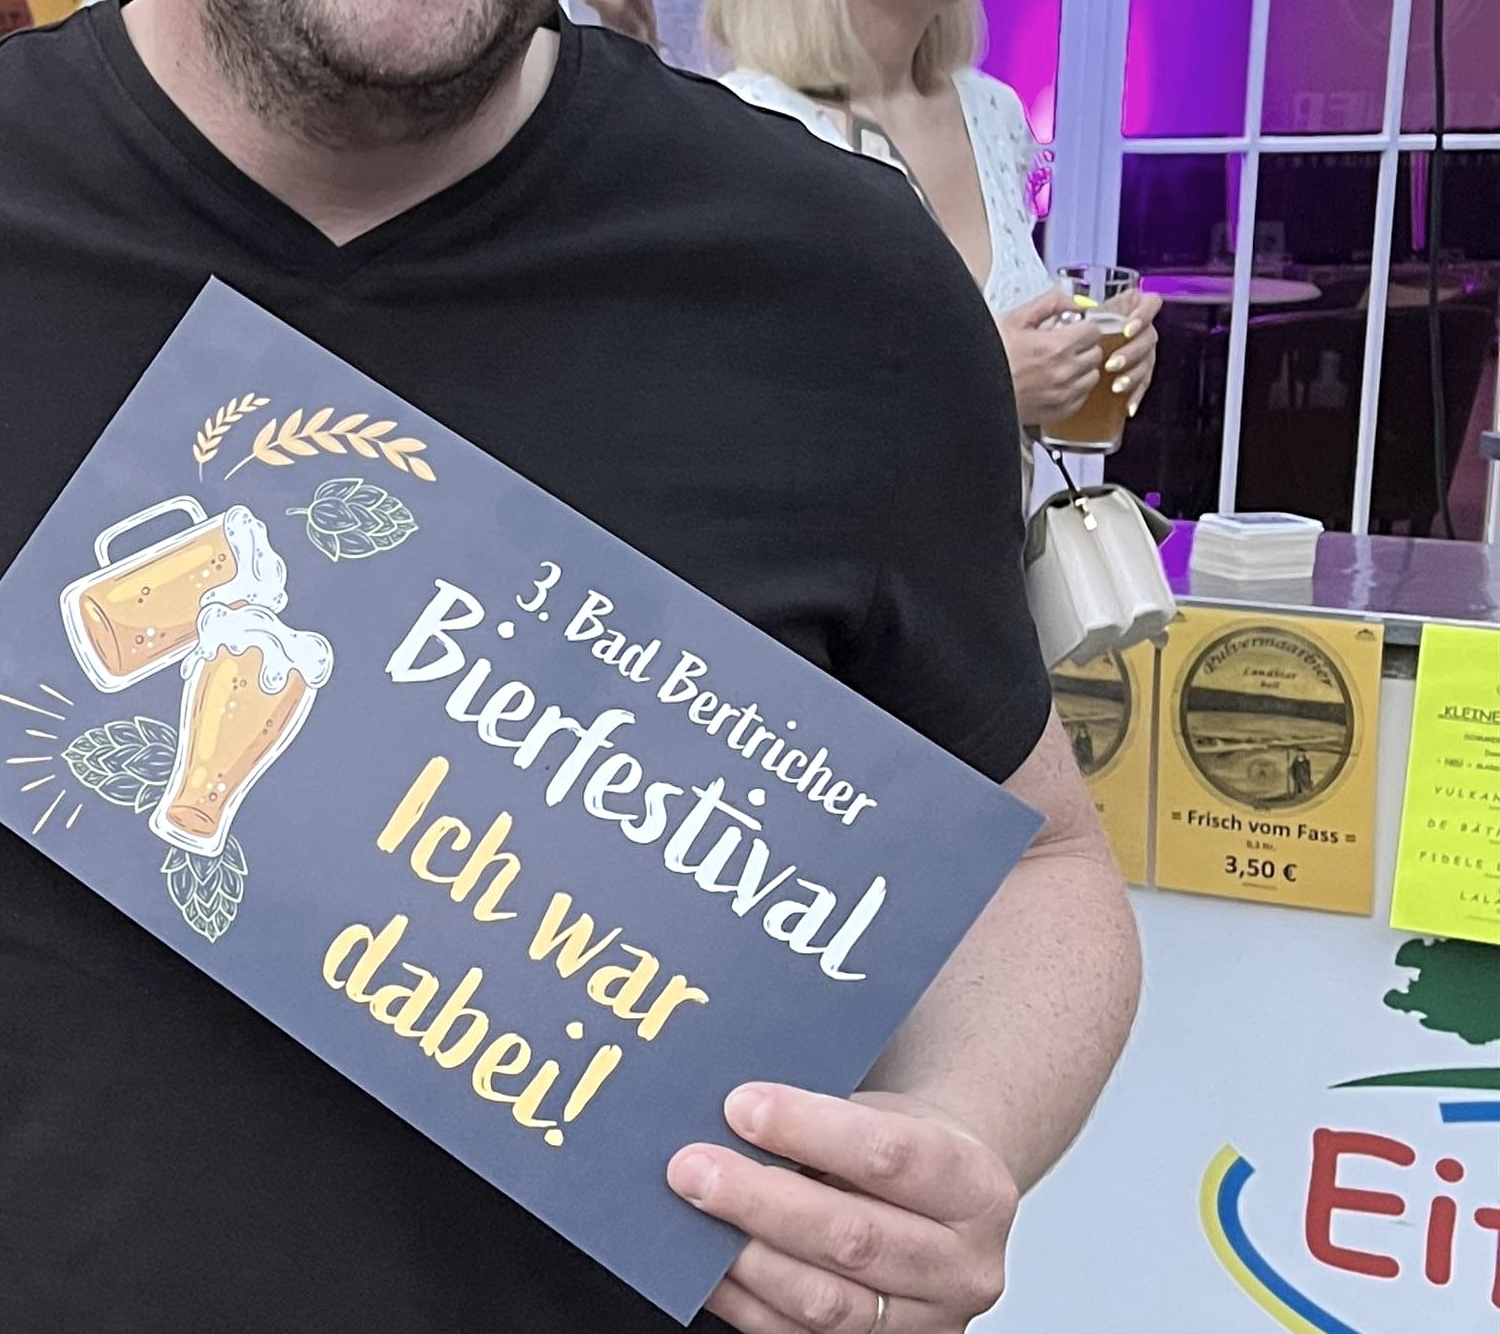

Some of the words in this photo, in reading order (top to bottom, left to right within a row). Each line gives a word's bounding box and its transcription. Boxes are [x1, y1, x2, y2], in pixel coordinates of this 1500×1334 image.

[385, 578, 887, 980] Bierfestival
[515, 561, 562, 622] 3.
[563, 589, 661, 684] Bad
[656, 650, 878, 826] Bertricher
[376, 755, 522, 922] Ich
[528, 892, 711, 1042] war
[1187, 810, 1242, 832] Frisch
[1248, 820, 1291, 838] vom
[1297, 823, 1339, 844] Fass
[1224, 854, 1276, 879] 3,50
[1283, 863, 1298, 883] €
[322, 914, 623, 1147] dabei!
